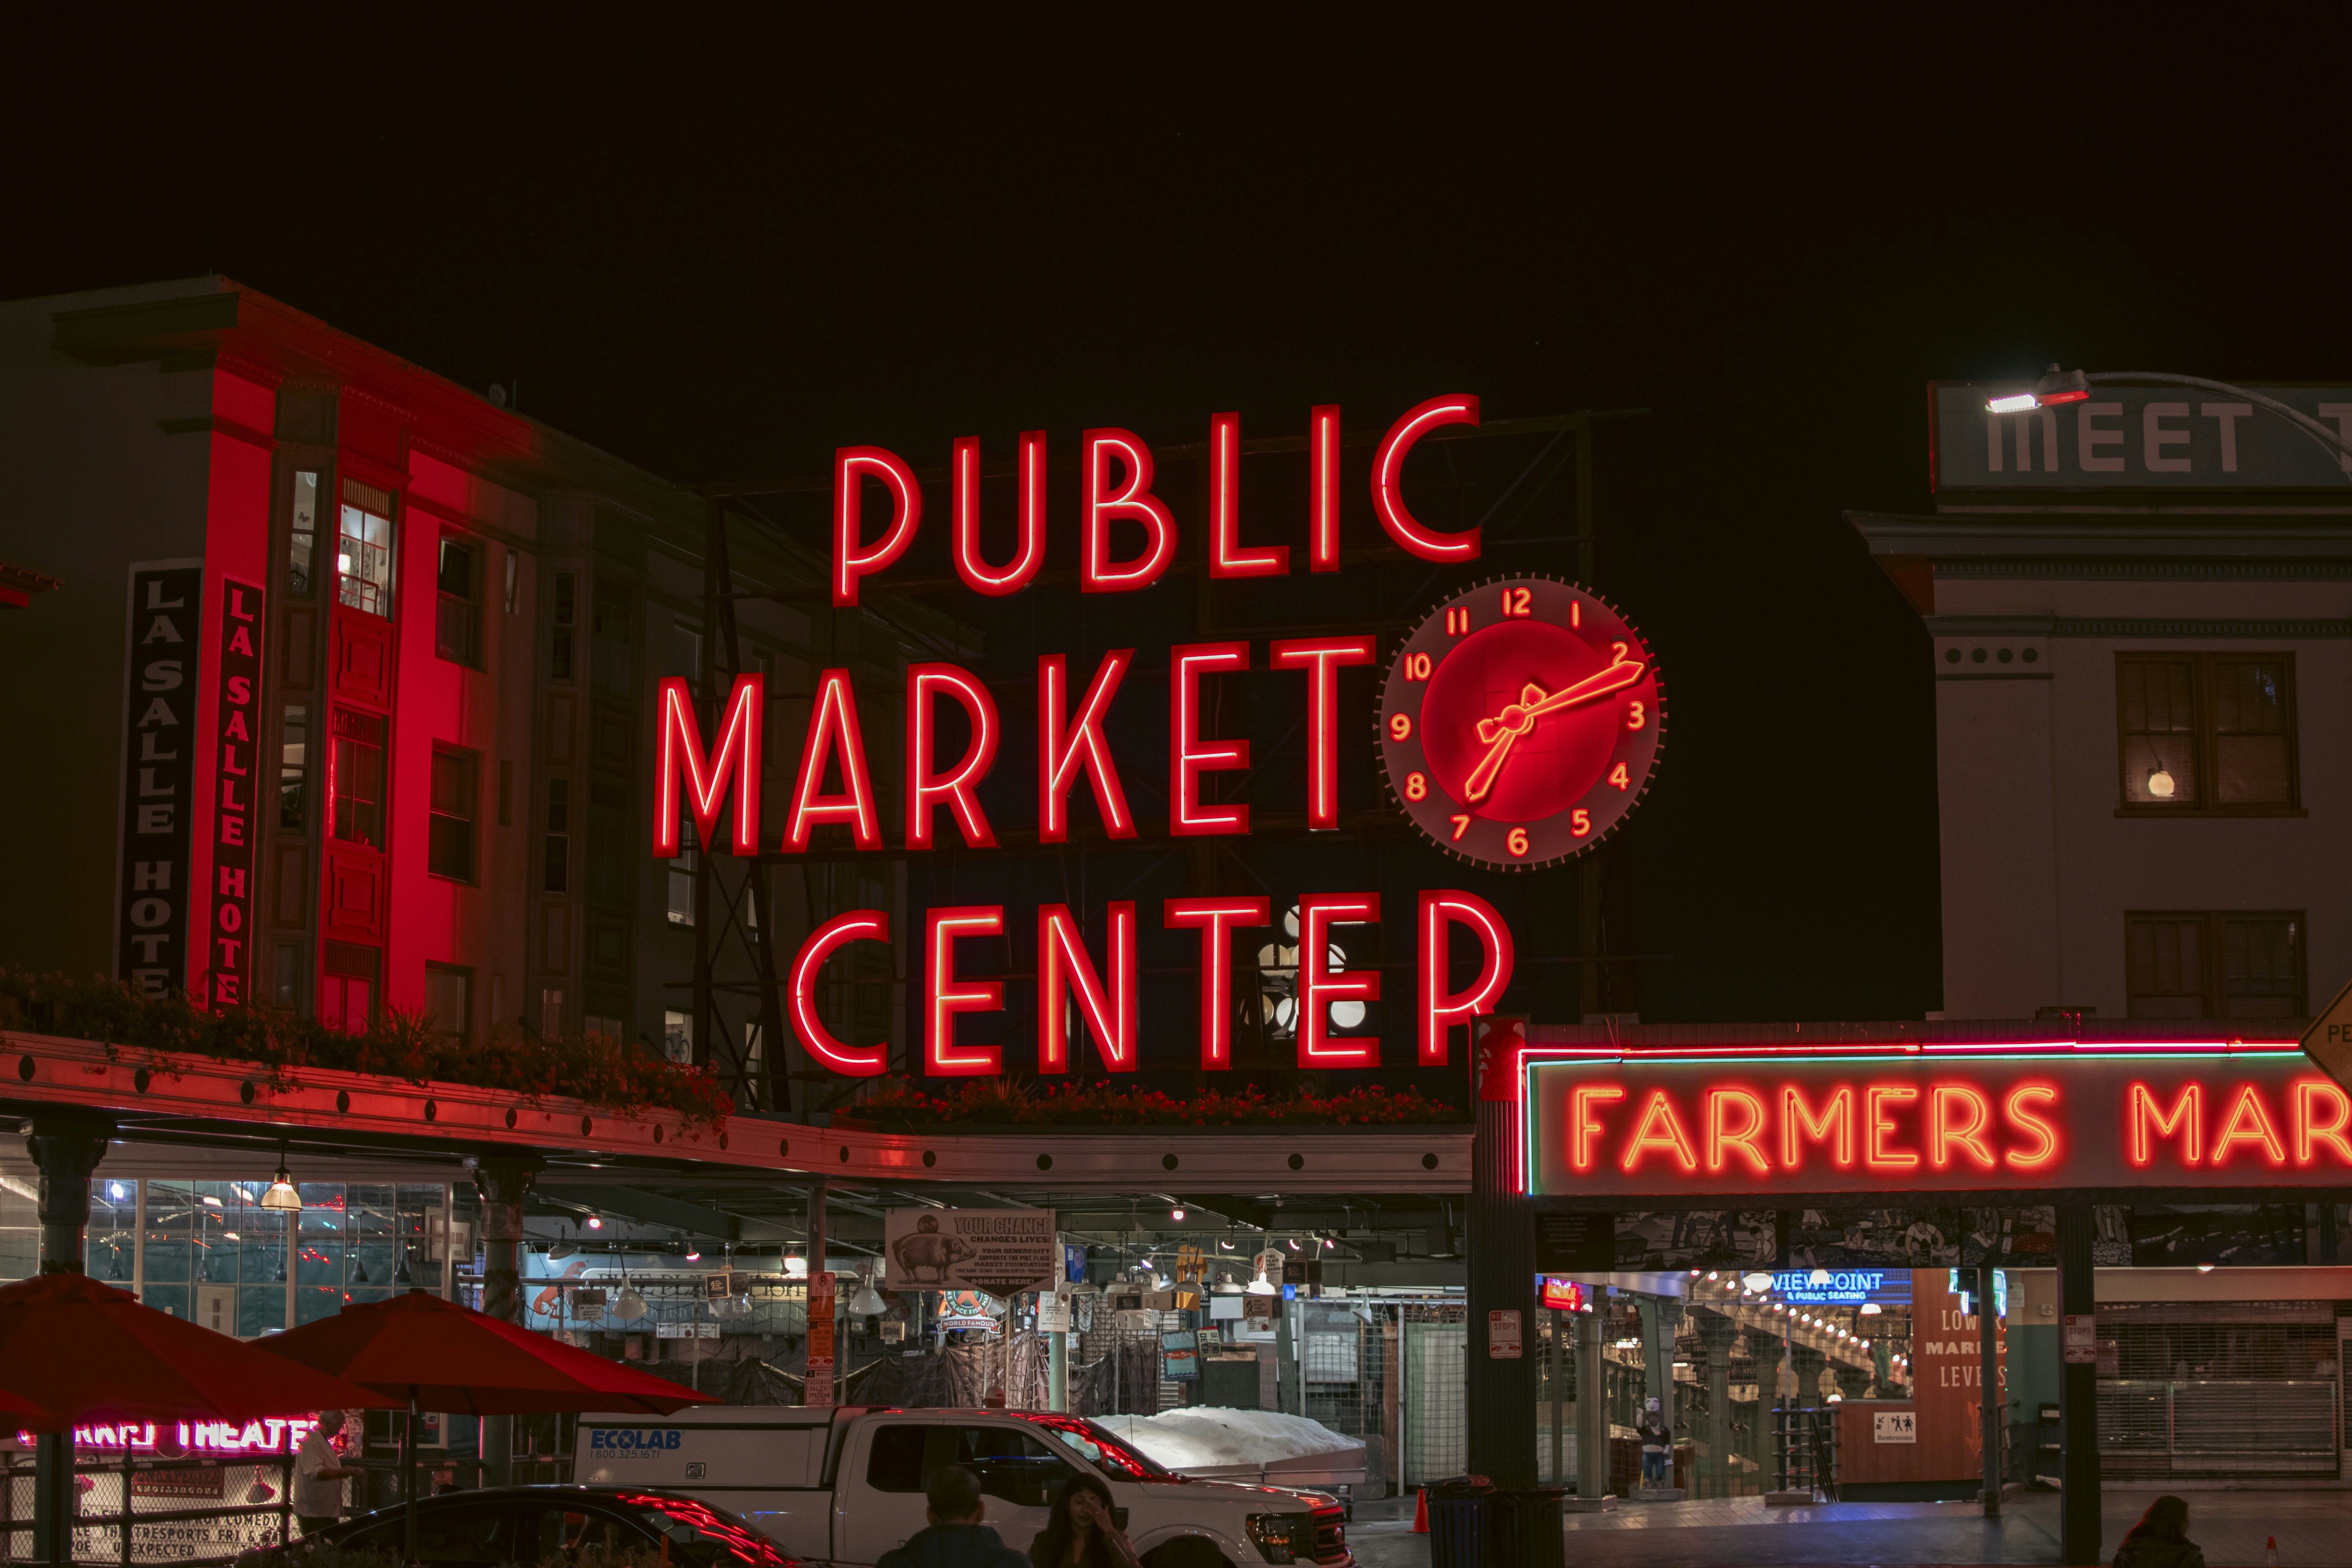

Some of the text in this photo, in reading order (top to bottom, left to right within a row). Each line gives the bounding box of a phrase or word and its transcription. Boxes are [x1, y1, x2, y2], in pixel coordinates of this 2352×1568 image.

[1987, 403, 2253, 472] MEET
[831, 393, 1481, 607] PUBLIC
[141, 580, 185, 645] LA
[1501, 587, 1533, 617] 12
[1570, 600, 1580, 629] 1
[229, 588, 254, 657] LA
[1446, 606, 1470, 637] 11
[1403, 652, 1433, 681] 10
[1612, 641, 1628, 665] 2
[1389, 713, 1413, 742] 9
[1627, 701, 1645, 731] 3
[136, 660, 184, 834] SALLE
[220, 675, 251, 847] SALLE
[651, 634, 1376, 859] MARKET
[1404, 771, 1429, 802] 8
[1608, 762, 1631, 791] 4
[1449, 814, 1471, 841] 7
[1571, 808, 1591, 837] 5
[1505, 828, 1530, 858] 6
[786, 887, 1514, 1076] CENTER
[2328, 1024, 2352, 1043] PE
[1573, 1083, 2352, 1168] FARMERS MAR
[954, 1217, 1051, 1234] YOUR CHANGE
[950, 1301, 967, 1315] PLACE
[969, 1305, 983, 1315] FISH
[1787, 1291, 1866, 1301] & PUBLIC SEATING
[1200, 1333, 1209, 1353] DEEP
[591, 1429, 681, 1450] ECOLAB
[590, 1450, 660, 1459] 1.800.325.1671
[218, 1530, 239, 1541] FRI
